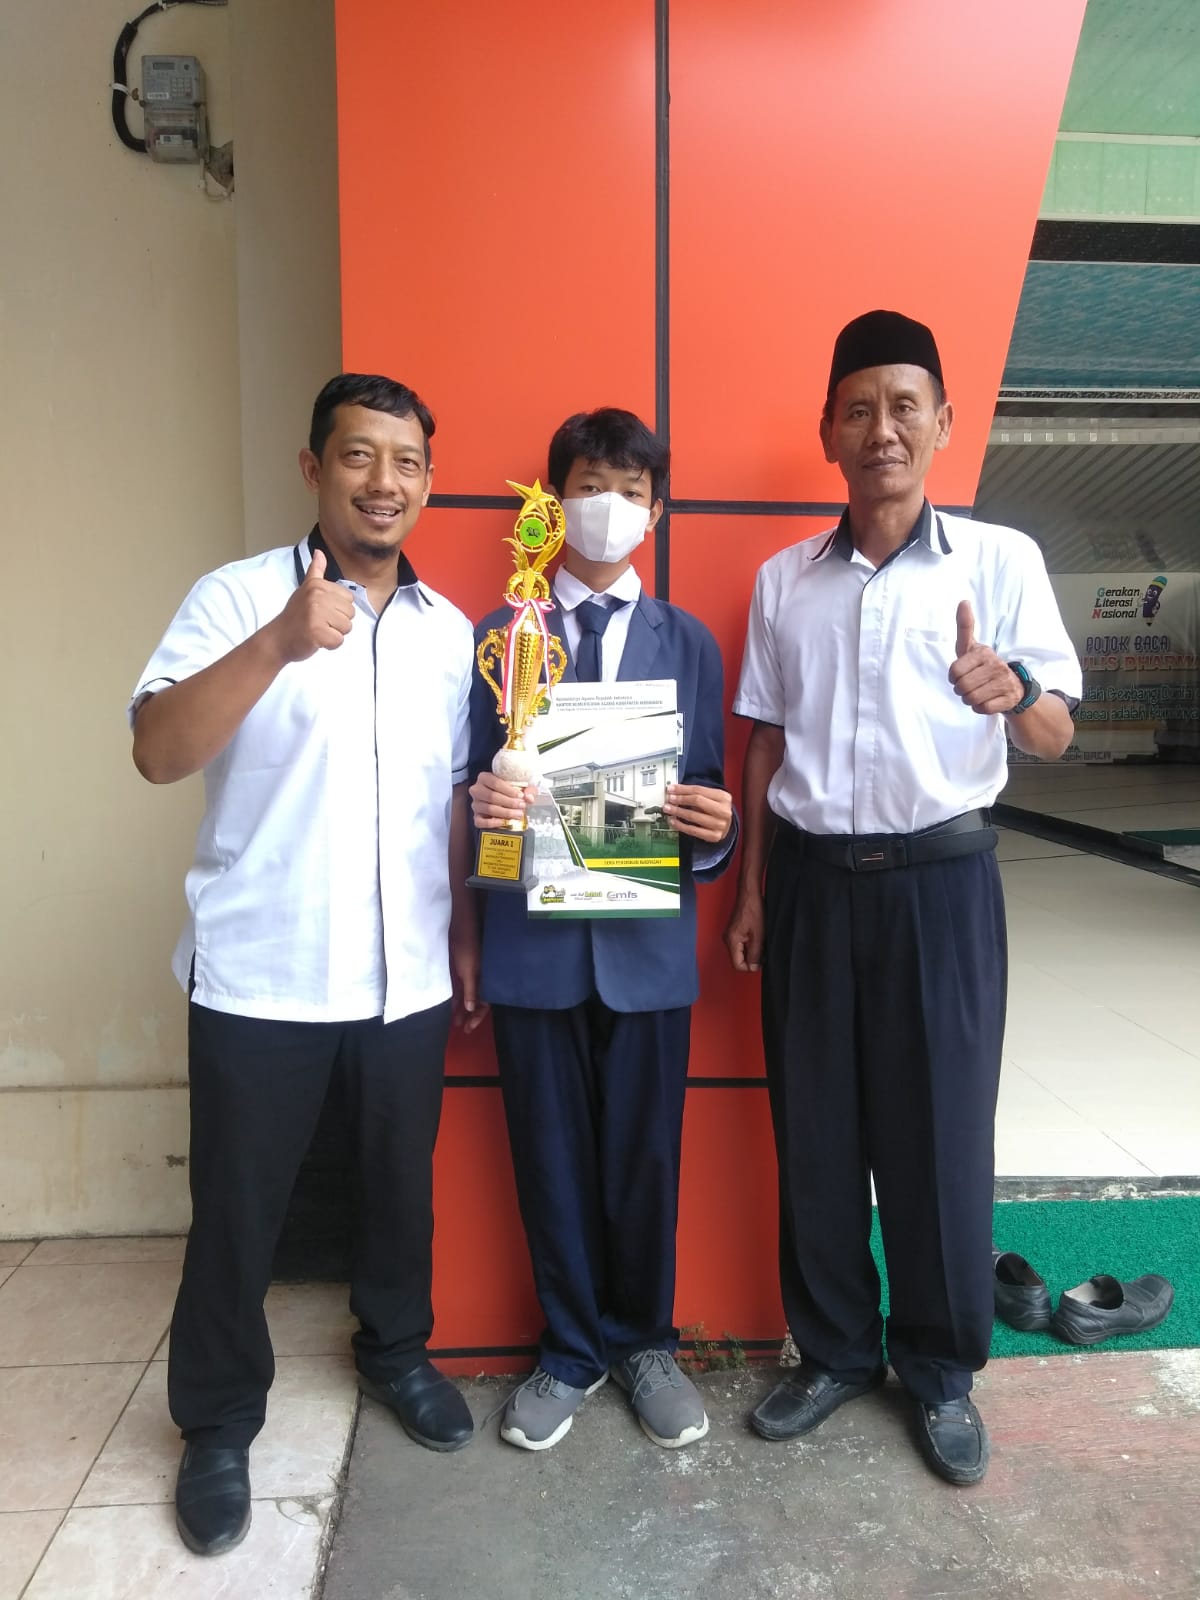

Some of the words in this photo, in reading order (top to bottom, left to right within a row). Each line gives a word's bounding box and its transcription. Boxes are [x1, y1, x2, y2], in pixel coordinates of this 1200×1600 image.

[1097, 587, 1140, 598] Gerakan
[1095, 598, 1133, 608] Literasi
[1092, 608, 1138, 619] Nasional
[1086, 636, 1129, 654] POJOK
[1135, 635, 1169, 652] BACA
[490, 838, 509, 848] JUARA
